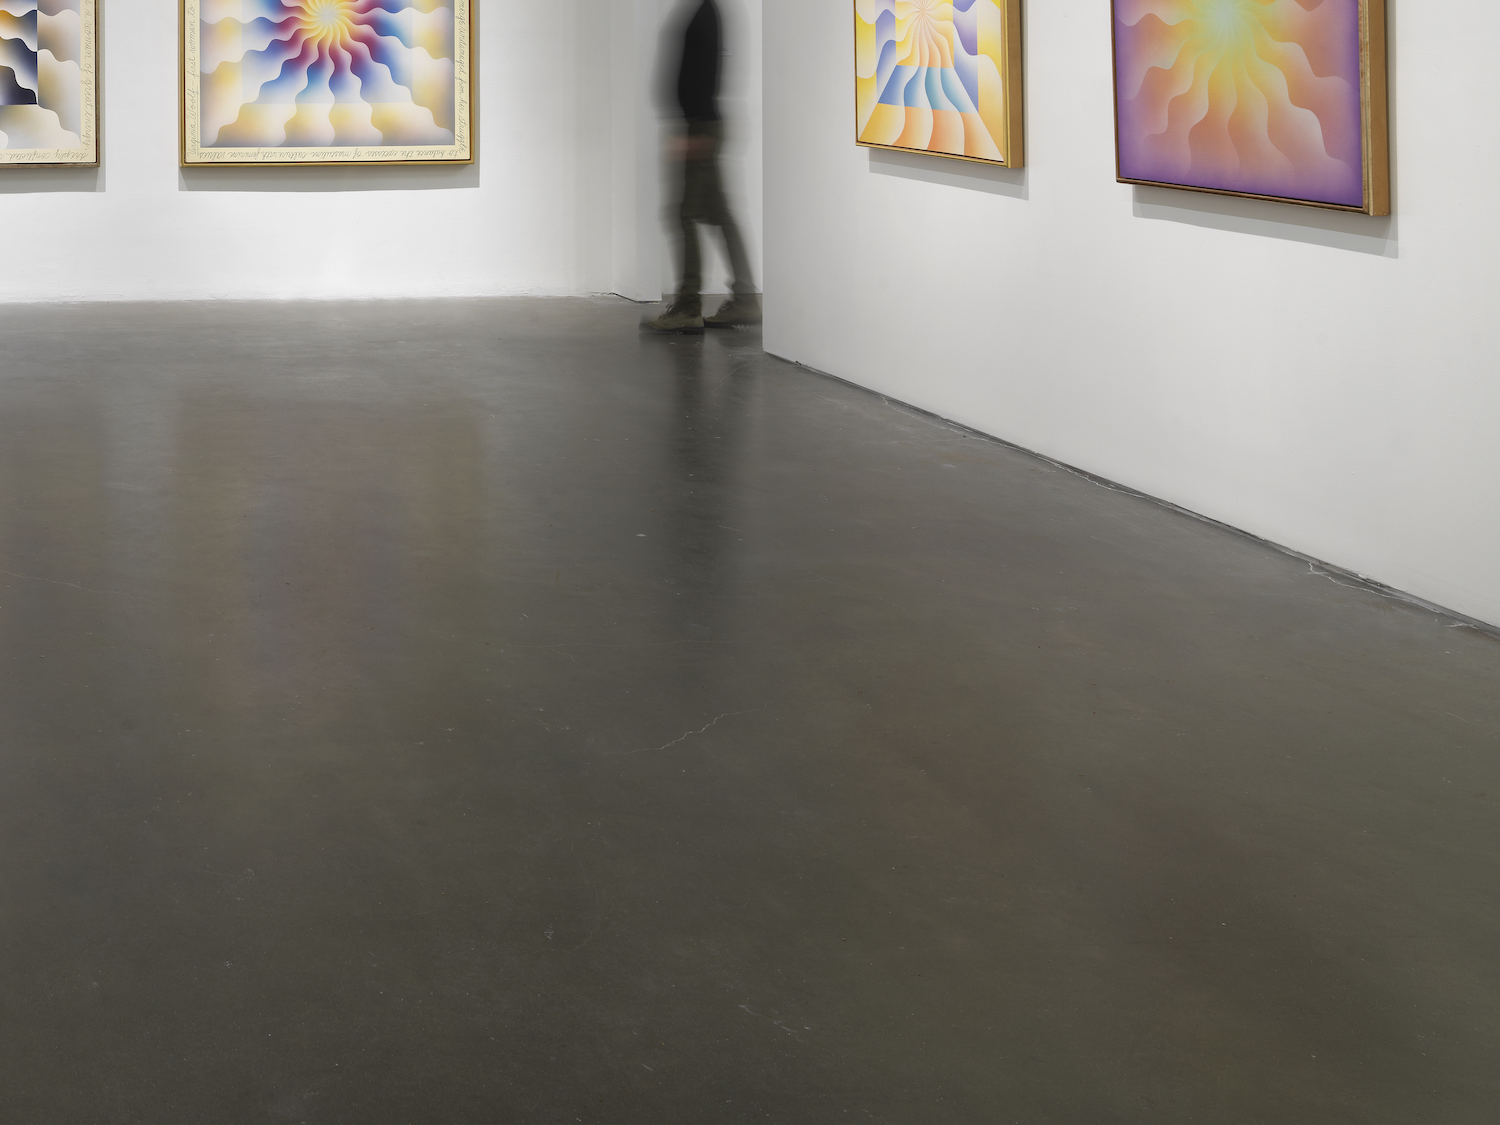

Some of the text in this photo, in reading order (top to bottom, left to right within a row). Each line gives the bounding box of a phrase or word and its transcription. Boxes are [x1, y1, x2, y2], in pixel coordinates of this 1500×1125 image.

[84, 8, 92, 18] a
[187, 3, 195, 17] to
[84, 20, 92, 60] woman
[455, 25, 467, 75] undamaged
[81, 62, 93, 74] of
[187, 55, 200, 79] first
[81, 77, 94, 108] great
[455, 77, 467, 95] from
[187, 87, 199, 122] Woolf
[459, 96, 467, 114] her
[187, 123, 200, 157] Virginia
[456, 115, 467, 154] struggle
[54, 149, 88, 161] deeply
[199, 148, 459, 161] to balance the excesses of masculine culture with feminine values
